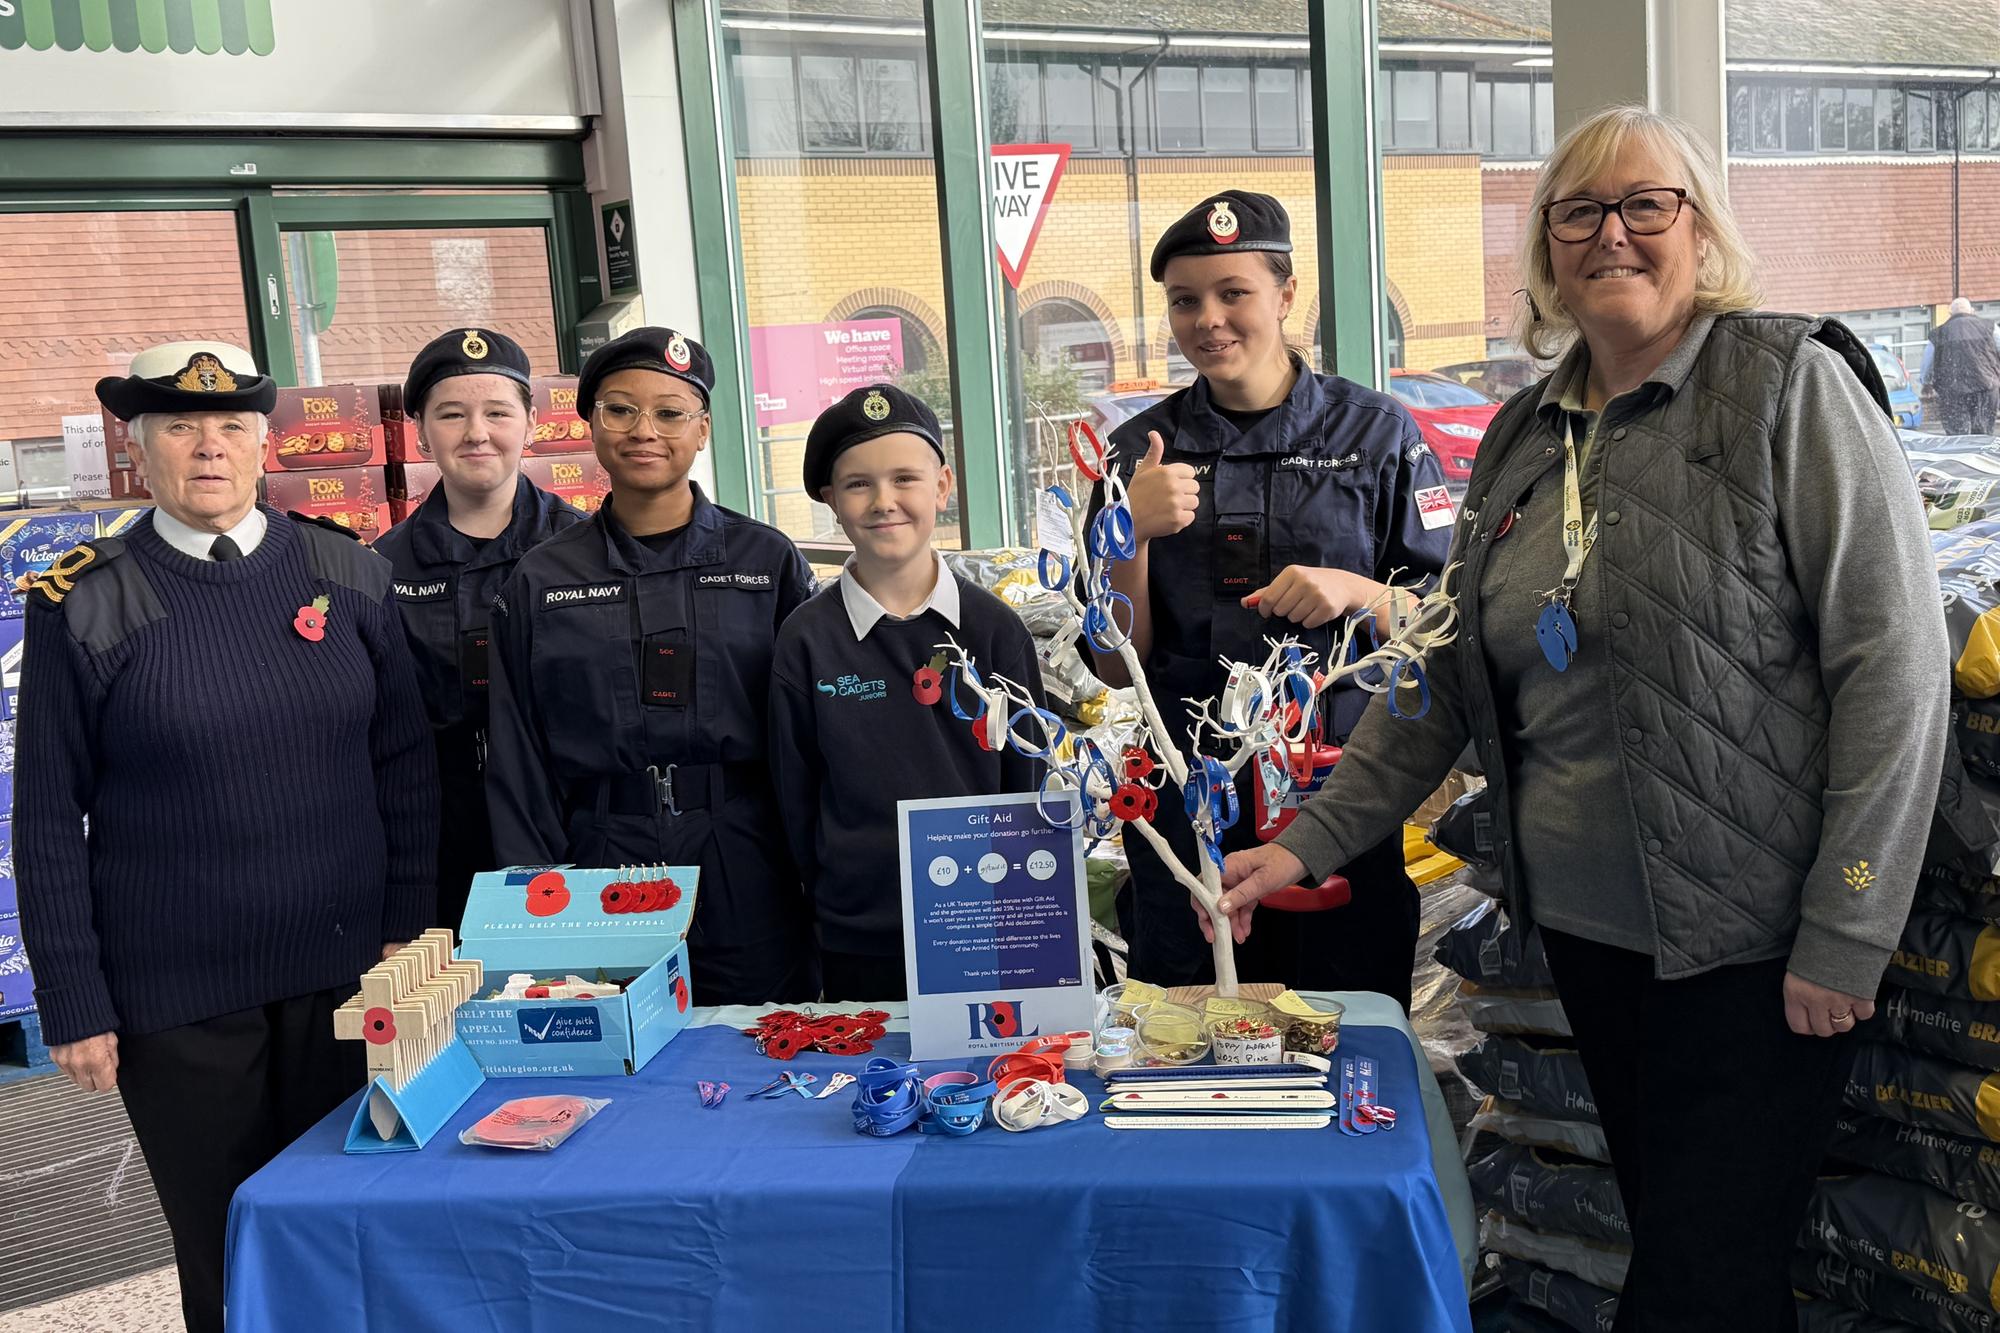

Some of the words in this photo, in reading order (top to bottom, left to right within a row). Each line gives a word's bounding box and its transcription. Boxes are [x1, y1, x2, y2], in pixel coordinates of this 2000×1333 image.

[824, 331, 850, 344] We
[852, 329, 891, 342] have
[845, 345, 867, 353] Office
[868, 343, 891, 353] space
[836, 355, 867, 364] Meeting
[841, 365, 867, 373] Virtual
[820, 377, 837, 386] High
[839, 376, 863, 385] speed
[305, 413, 339, 421] CLASSIC
[65, 426, 84, 434] This
[82, 440, 92, 448] of
[1281, 457, 1315, 468] CADET
[1318, 453, 1358, 468] FORCES
[73, 473, 103, 481] Please
[311, 493, 345, 501] CLASSIC
[1227, 533, 1244, 541] SCC
[700, 574, 733, 585] CADET
[734, 573, 770, 586] FORCES
[418, 582, 447, 597] NAVY
[546, 587, 587, 604] ROYAL
[588, 585, 622, 600] NAVY
[837, 674, 861, 687] SEA
[838, 680, 887, 696] CADETS
[652, 690, 677, 698] CADET
[859, 691, 887, 701] JUNIORS
[967, 815, 990, 826] Gift
[993, 812, 1012, 824] Aid
[927, 833, 953, 842] Helping
[973, 831, 989, 841] your
[990, 829, 1020, 838] donation
[1021, 830, 1030, 838] go
[936, 866, 951, 875] £10
[1029, 860, 1055, 870] £12.50
[957, 900, 980, 908] Taxpayer
[950, 908, 981, 916] government
[529, 921, 556, 929] HELP
[587, 920, 619, 928] POPPY
[625, 919, 665, 927] APPEAL
[956, 916, 967, 924] you
[946, 923, 971, 931] complete
[932, 939, 948, 947] Every
[1006, 934, 1032, 942] difference
[980, 970, 991, 978] you
[1013, 967, 1035, 975] support
[456, 1010, 486, 1019] HELP
[488, 1010, 513, 1019] THE
[556, 1017, 573, 1029] give
[575, 1017, 594, 1025] with
[461, 1024, 506, 1034] APPEAL
[551, 1027, 594, 1039] confidence
[1216, 1040, 1241, 1052] POPPY
[1216, 1054, 1240, 1064] 2025
[1891, 1250, 1969, 1294] BRAZIER
